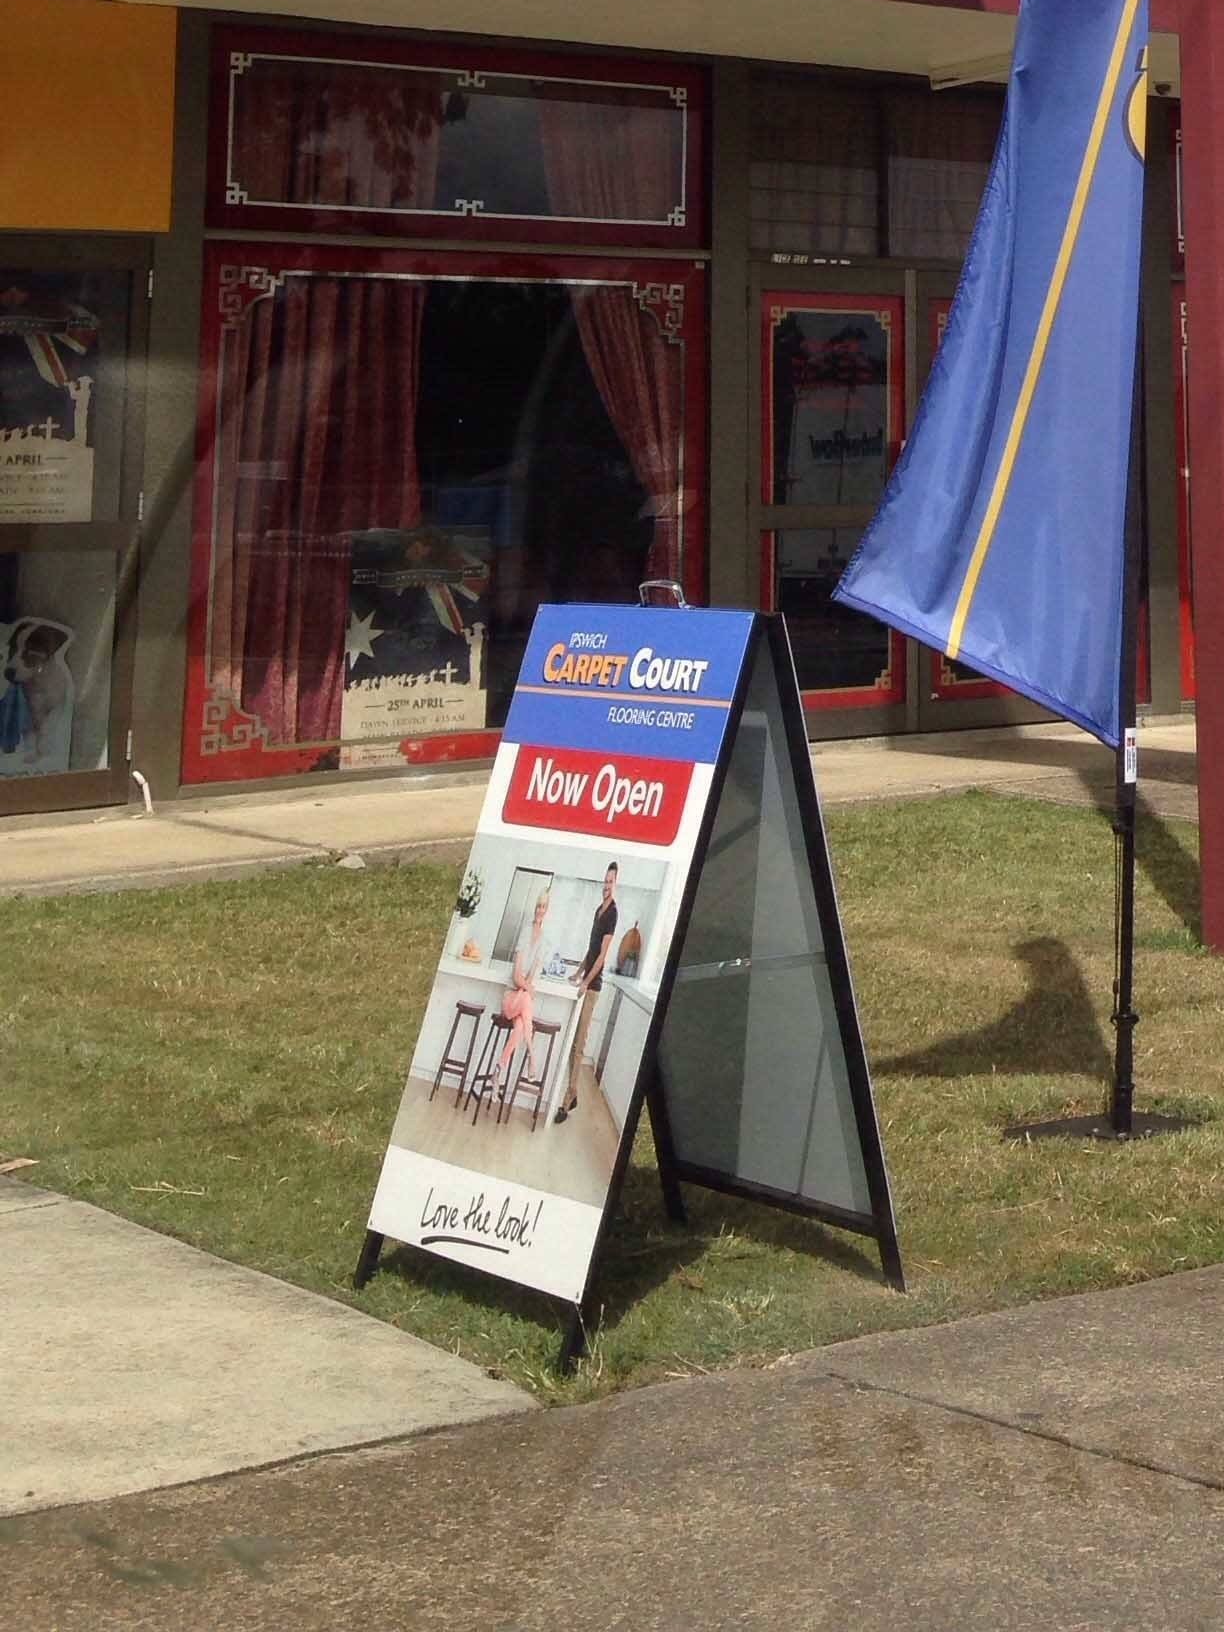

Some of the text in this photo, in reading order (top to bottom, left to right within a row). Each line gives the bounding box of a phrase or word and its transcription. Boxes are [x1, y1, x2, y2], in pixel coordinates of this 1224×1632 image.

[568, 632, 608, 649] IPSWICH
[543, 643, 709, 693] CARPET COURT
[412, 697, 445, 710] APRIL
[607, 706, 695, 729] FLOORING CENTRE
[525, 756, 664, 824] Now Open
[420, 1187, 544, 1248] Love the look!
